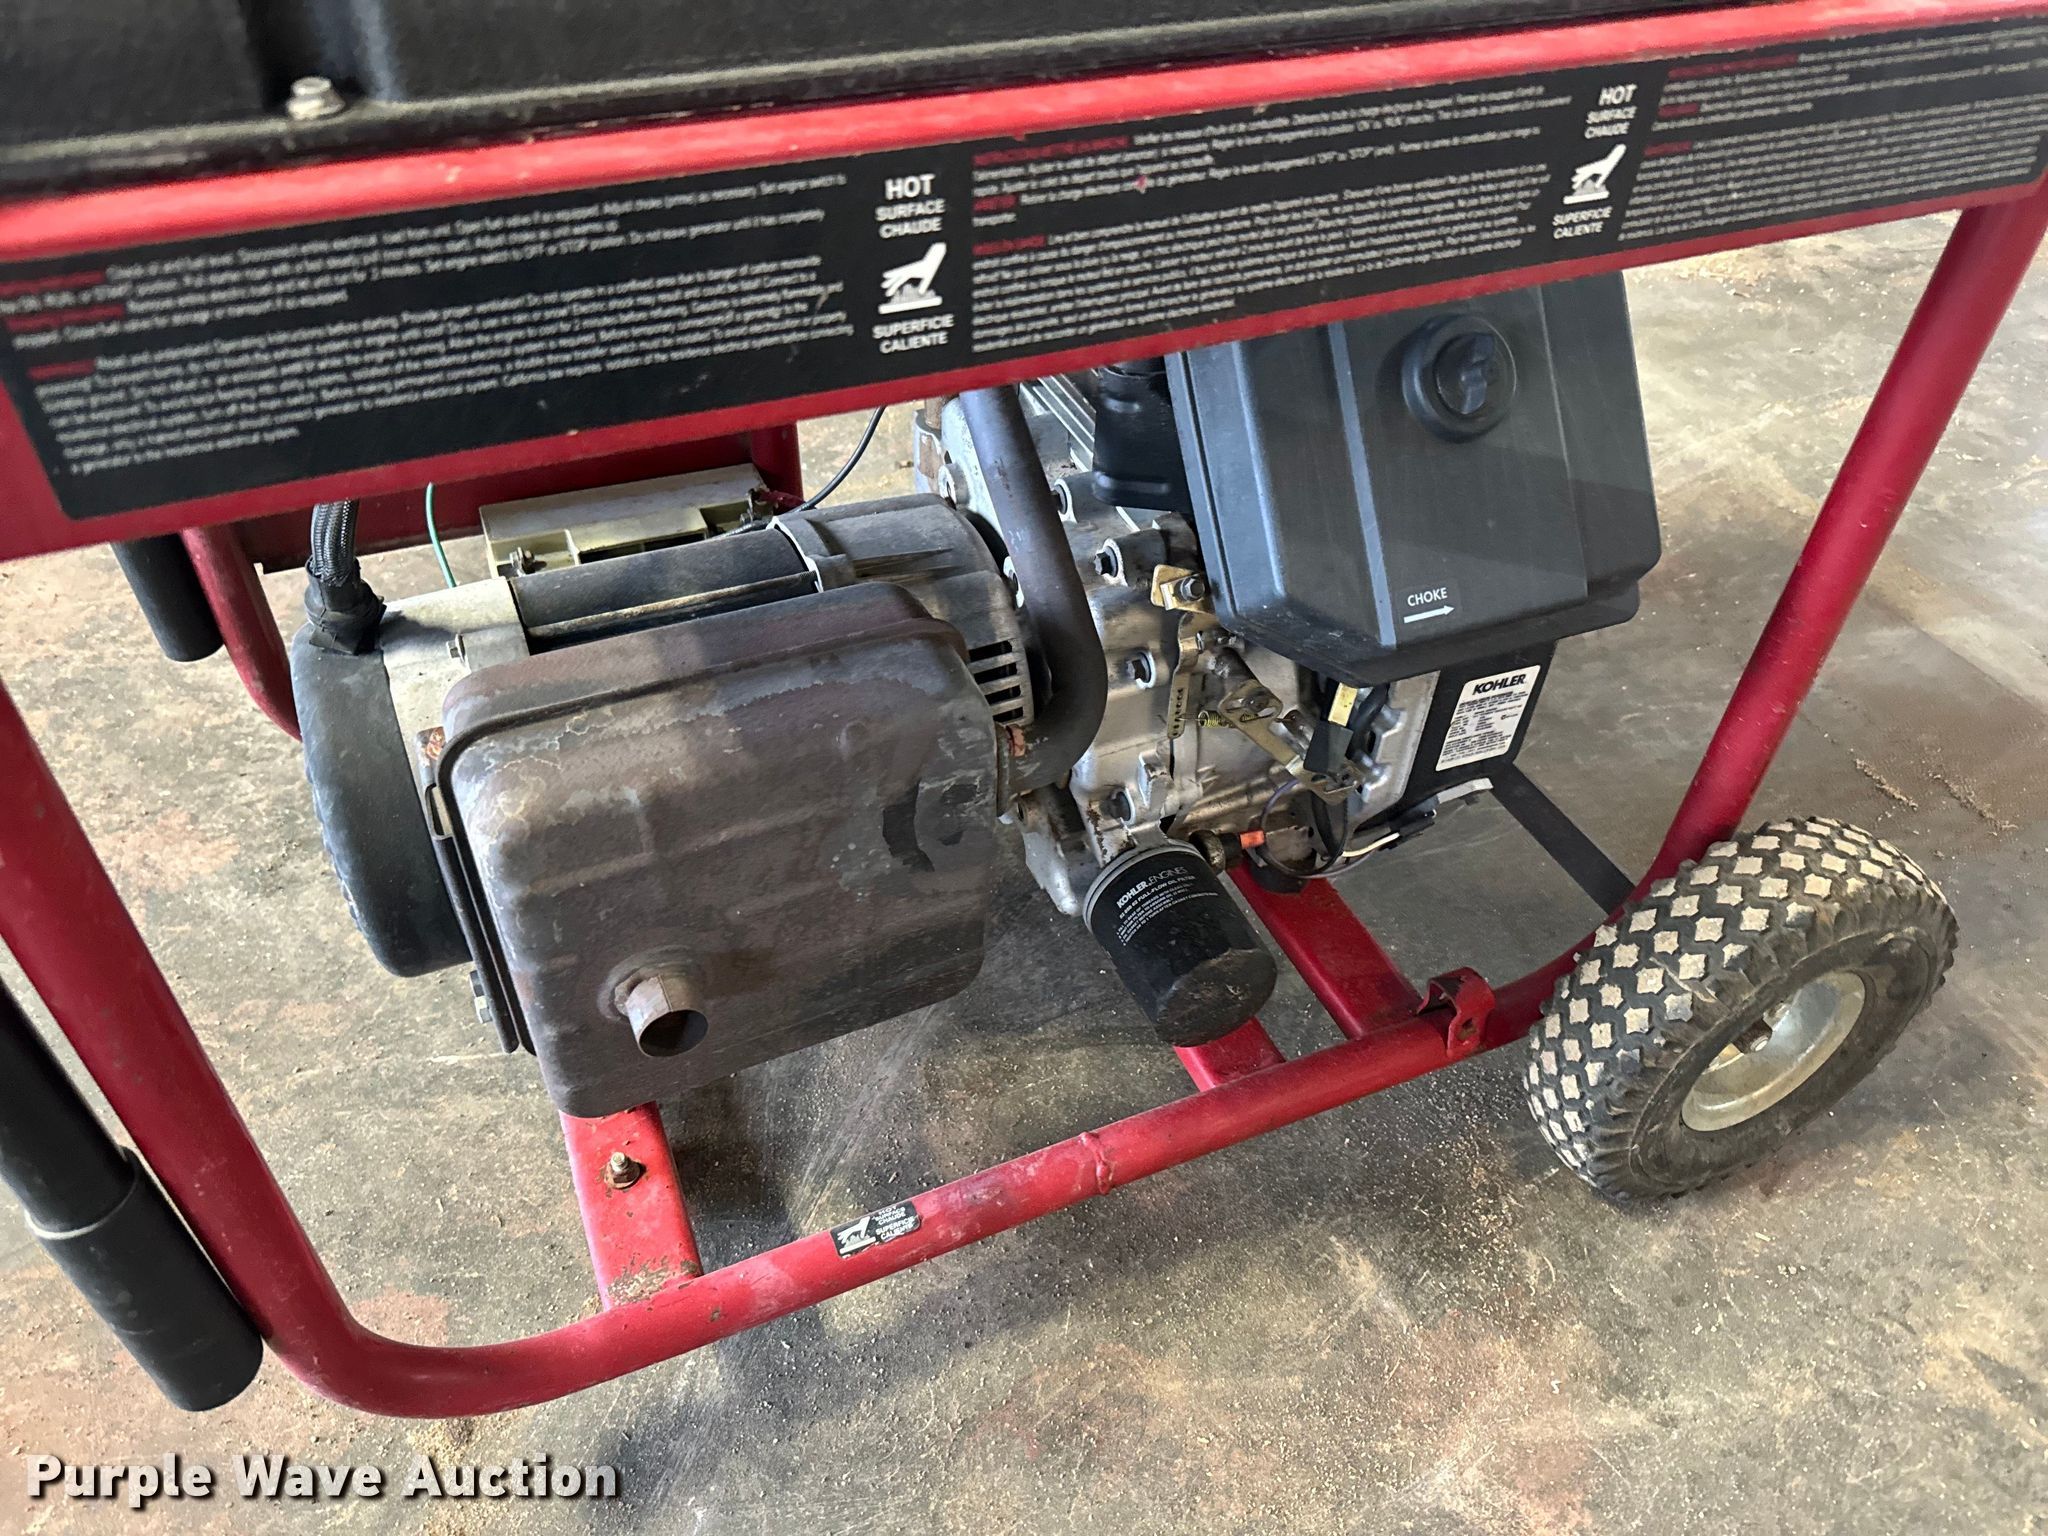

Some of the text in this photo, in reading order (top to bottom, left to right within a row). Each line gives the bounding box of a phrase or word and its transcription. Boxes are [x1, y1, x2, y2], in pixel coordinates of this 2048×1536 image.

[1598, 83, 1638, 106] HOT
[1586, 106, 1638, 124] SURFACE
[885, 173, 936, 200] HOT
[875, 198, 946, 221] SURFACE
[1552, 206, 1613, 226] SUPERFICIE
[879, 216, 942, 239] CHAUDE
[1553, 221, 1604, 239] CALIENTE
[872, 313, 954, 339] SUPERFICIE
[880, 330, 948, 354] CALIENTE
[1407, 587, 1448, 607] CHOKE
[1472, 673, 1526, 695] KOHLER
